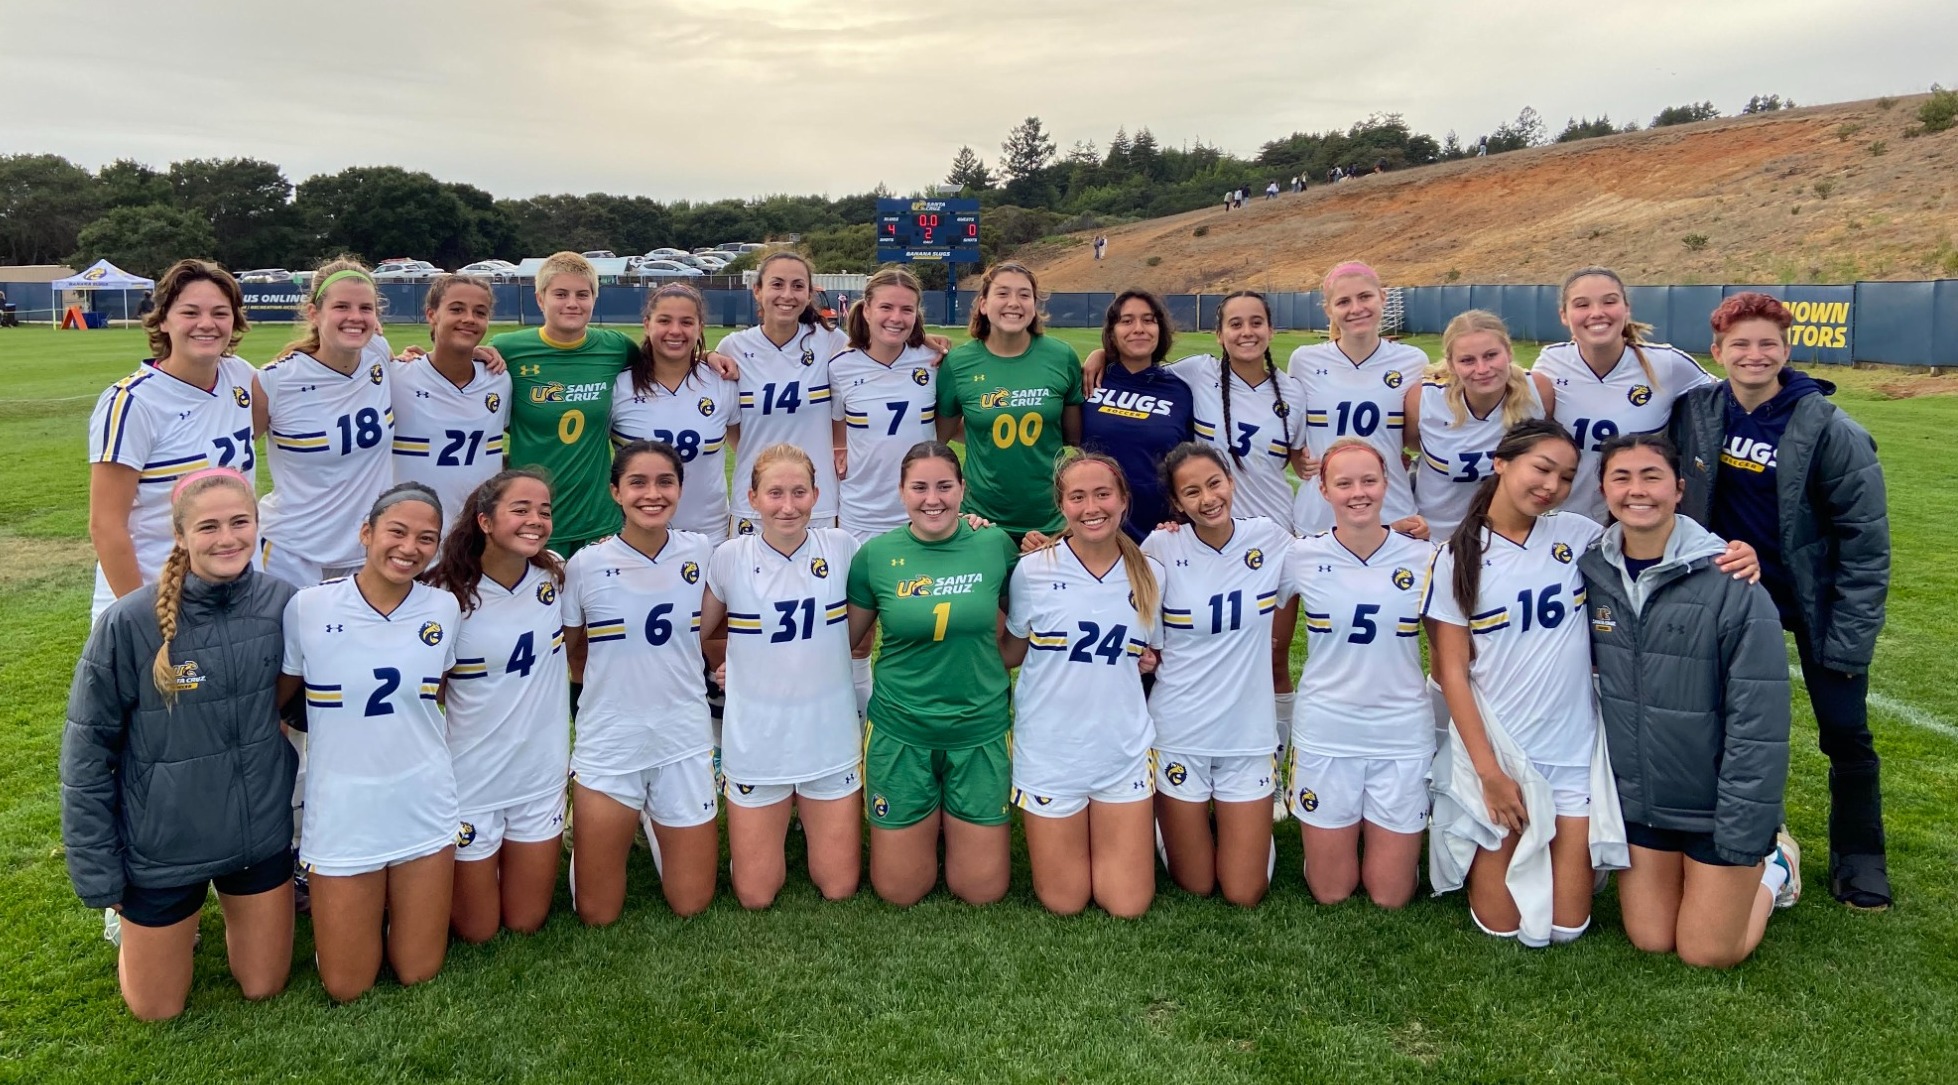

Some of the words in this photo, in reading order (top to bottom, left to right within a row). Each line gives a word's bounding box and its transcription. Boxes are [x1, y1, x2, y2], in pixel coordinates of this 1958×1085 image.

[888, 224, 896, 235] 4
[925, 227, 932, 239] 2
[969, 224, 976, 236] 0
[243, 294, 260, 303] US
[261, 294, 308, 303] ONLINE
[1786, 325, 1848, 348] TORS
[565, 391, 600, 402] CRUZ
[566, 382, 607, 394] SANTA
[762, 380, 802, 416] 14
[1010, 397, 1042, 407] CRUZ
[1011, 388, 1050, 399] SANTA
[1087, 387, 1174, 416] SLUGS
[558, 409, 585, 445] 0
[886, 401, 910, 436] 7
[992, 411, 1043, 449] 00
[1106, 408, 1142, 417] SOCCER
[1336, 400, 1380, 437] 10
[211, 426, 254, 472] 23
[336, 407, 382, 456] 18
[436, 429, 484, 466] 21
[1228, 421, 1261, 457] 3
[1573, 417, 1620, 452] 19
[933, 583, 973, 596] CRUZ
[934, 573, 983, 587] SANTA
[645, 602, 674, 646] 6
[770, 597, 816, 644] 31
[932, 602, 952, 641] 1
[1208, 589, 1242, 635] 11
[1347, 603, 1381, 645] 5
[1517, 583, 1566, 633] 16
[505, 630, 536, 678] 4
[1068, 620, 1128, 666] 24
[364, 666, 401, 717] 2
